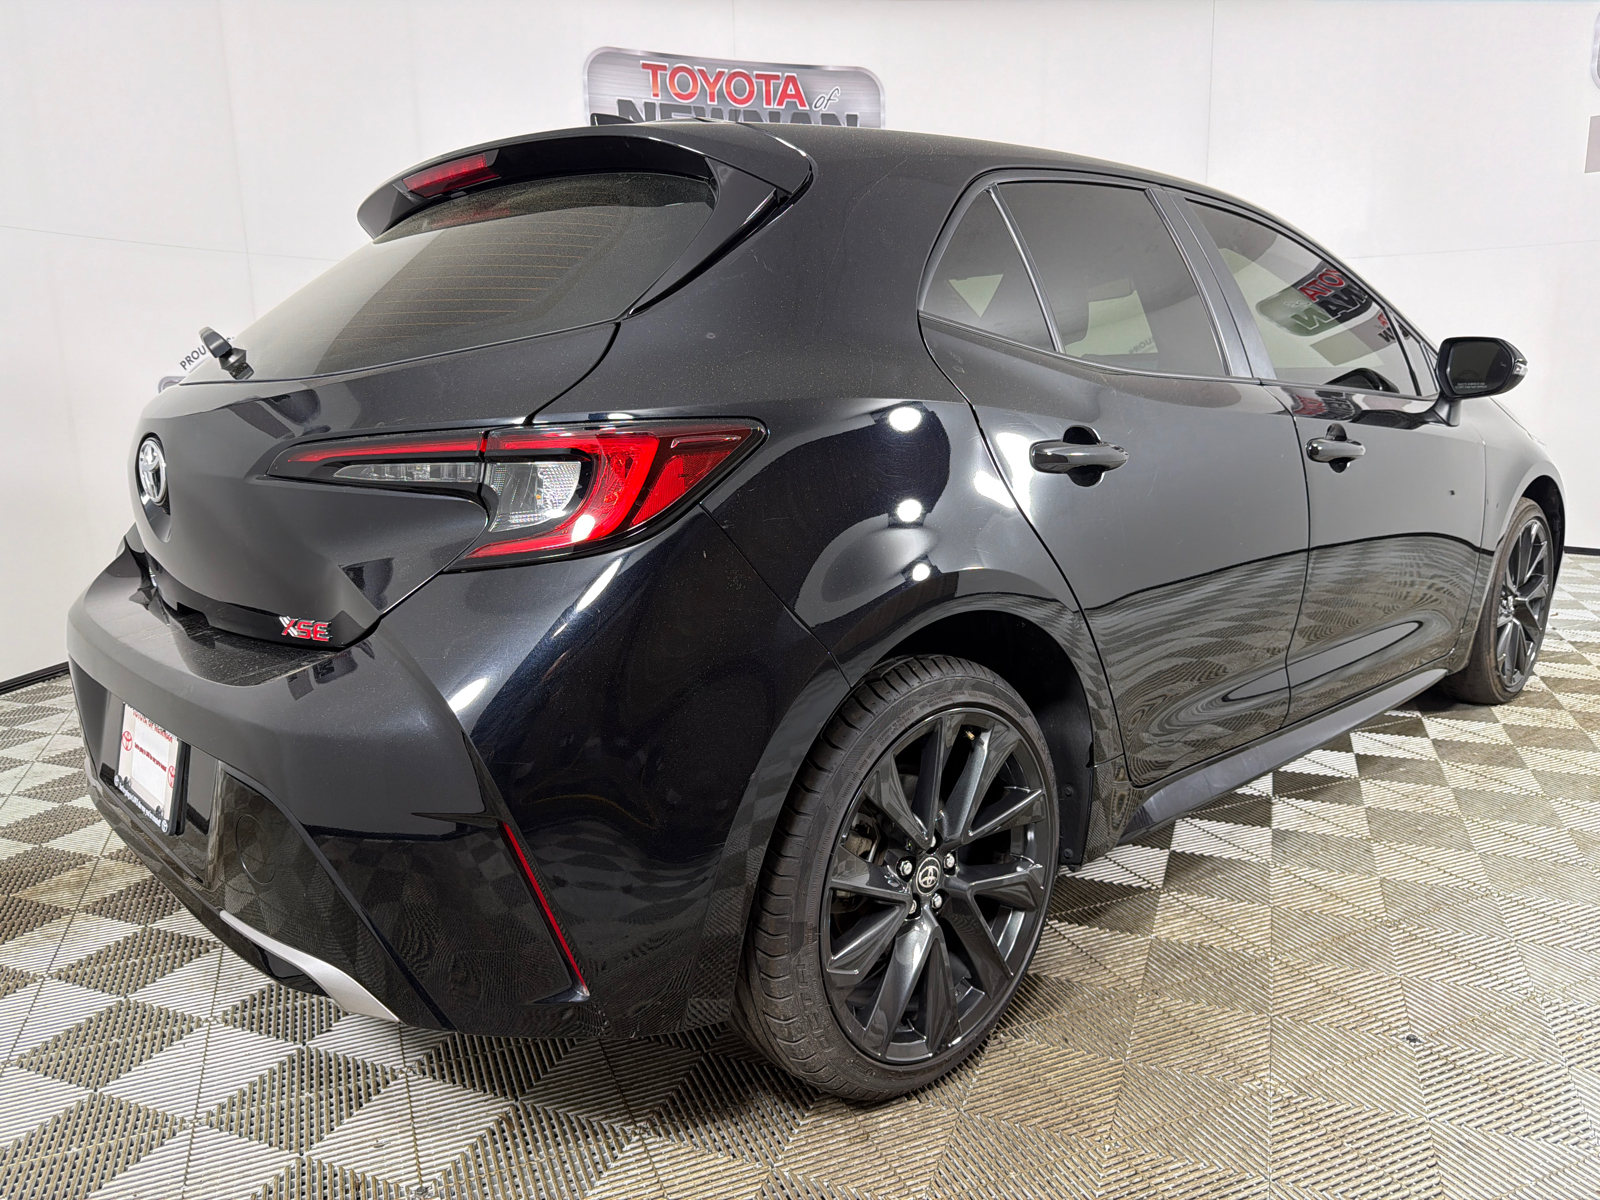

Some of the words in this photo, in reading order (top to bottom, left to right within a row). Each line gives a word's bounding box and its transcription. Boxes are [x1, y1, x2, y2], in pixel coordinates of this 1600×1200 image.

[640, 61, 808, 109] TOYOTA
[813, 87, 840, 110] of
[179, 345, 207, 371] PROU
[279, 616, 332, 642] XSE
